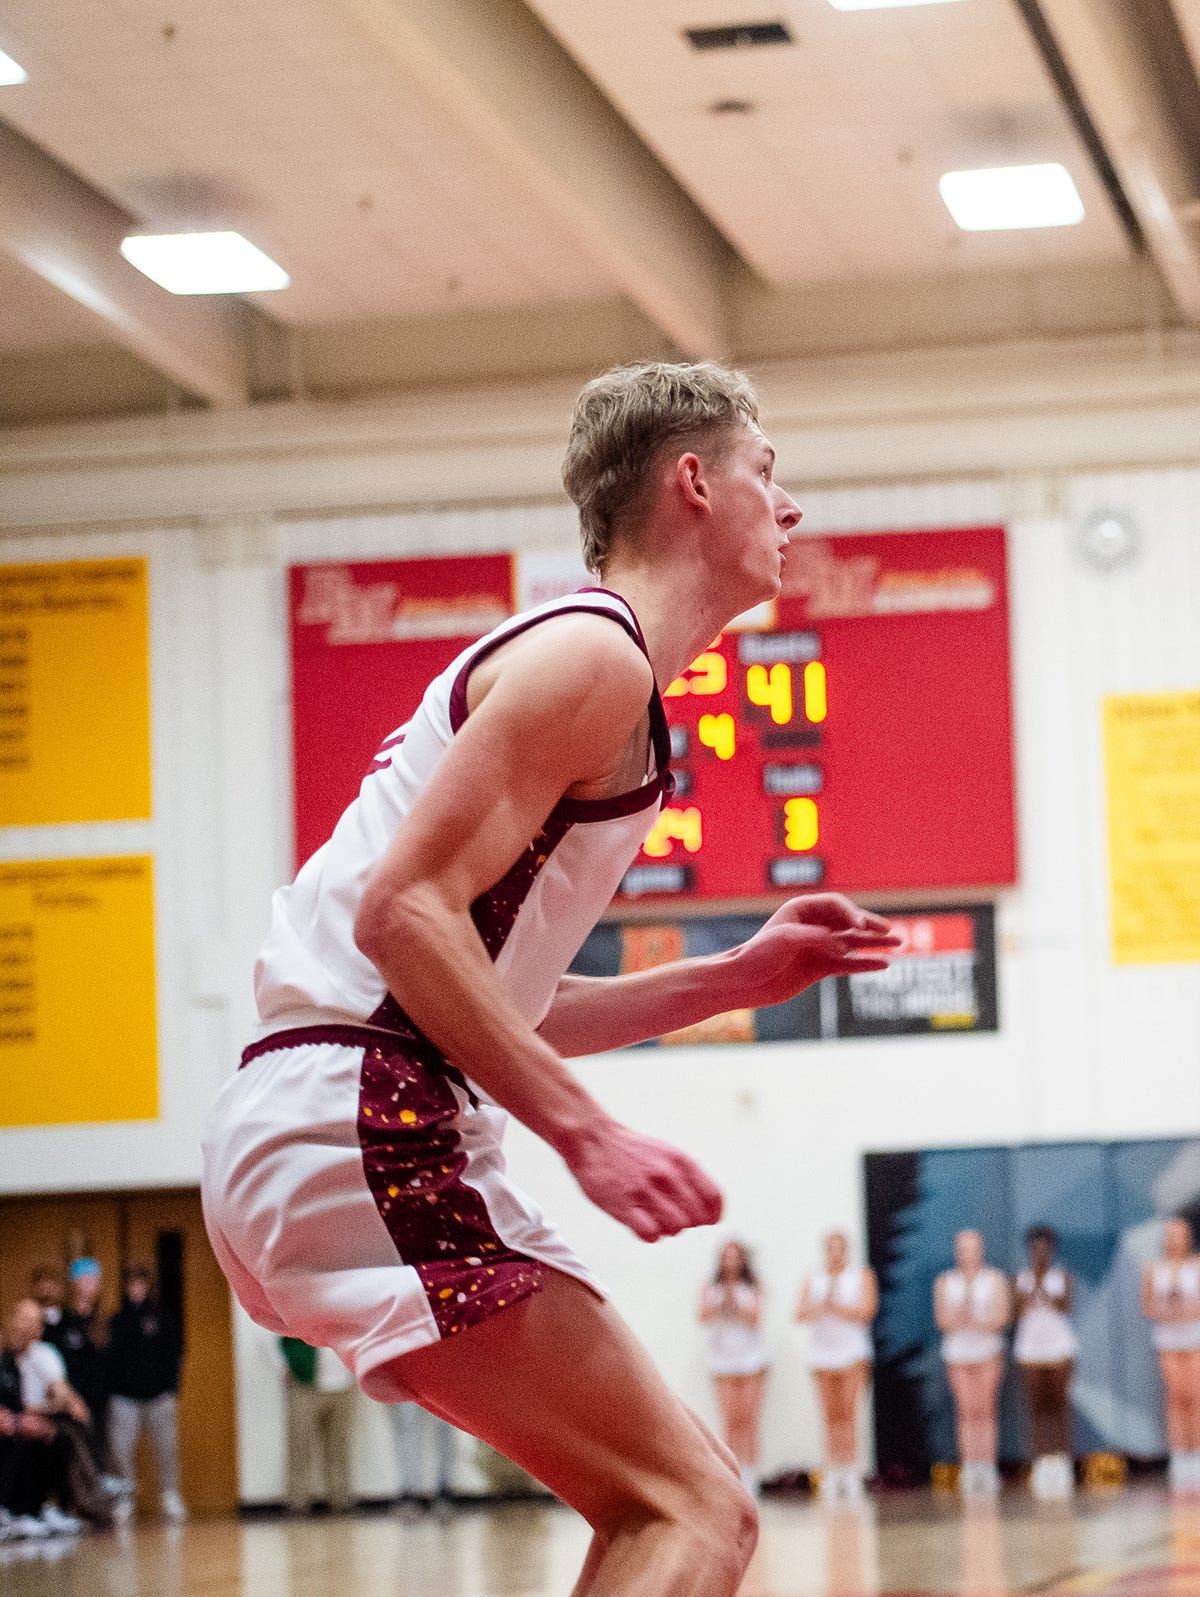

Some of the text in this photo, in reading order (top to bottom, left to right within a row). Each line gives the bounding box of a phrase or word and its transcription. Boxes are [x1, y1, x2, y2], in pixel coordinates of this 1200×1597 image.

[662, 632, 727, 697] 5
[746, 660, 828, 726] 41
[698, 713, 736, 760] 4
[784, 797, 819, 851] 3
